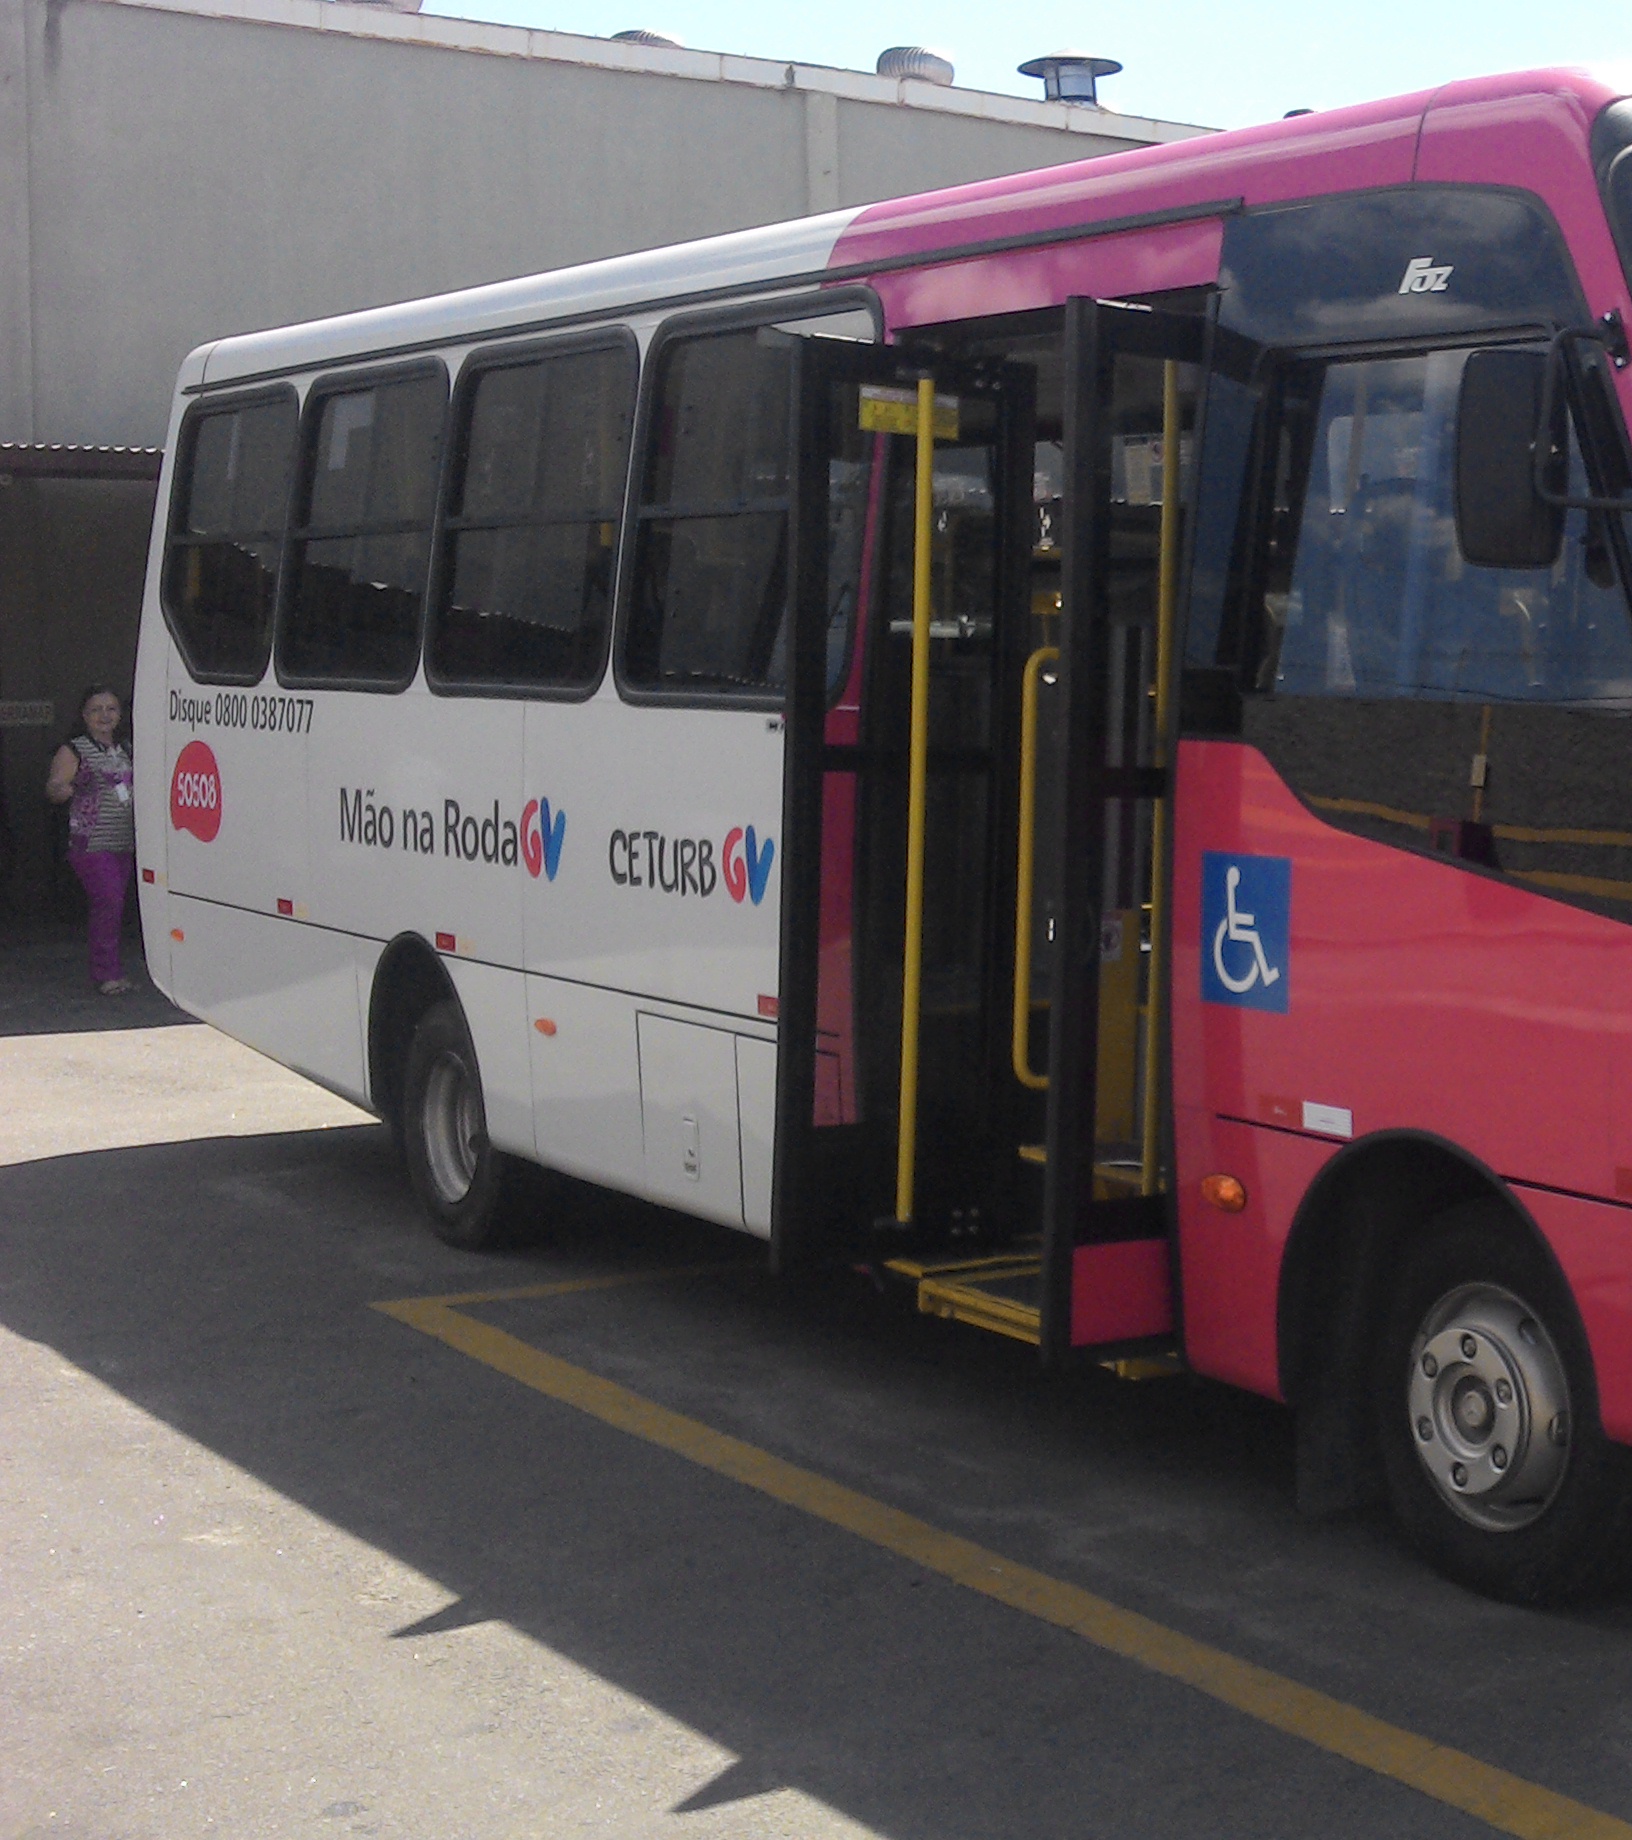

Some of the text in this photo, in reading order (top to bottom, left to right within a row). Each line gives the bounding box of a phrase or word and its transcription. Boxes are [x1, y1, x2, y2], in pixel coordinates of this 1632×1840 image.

[169, 689, 314, 733] Disque 0800 0387077
[178, 771, 217, 810] 50508
[340, 787, 395, 848] Mão
[402, 808, 434, 855] na
[609, 829, 717, 898] CETURB
